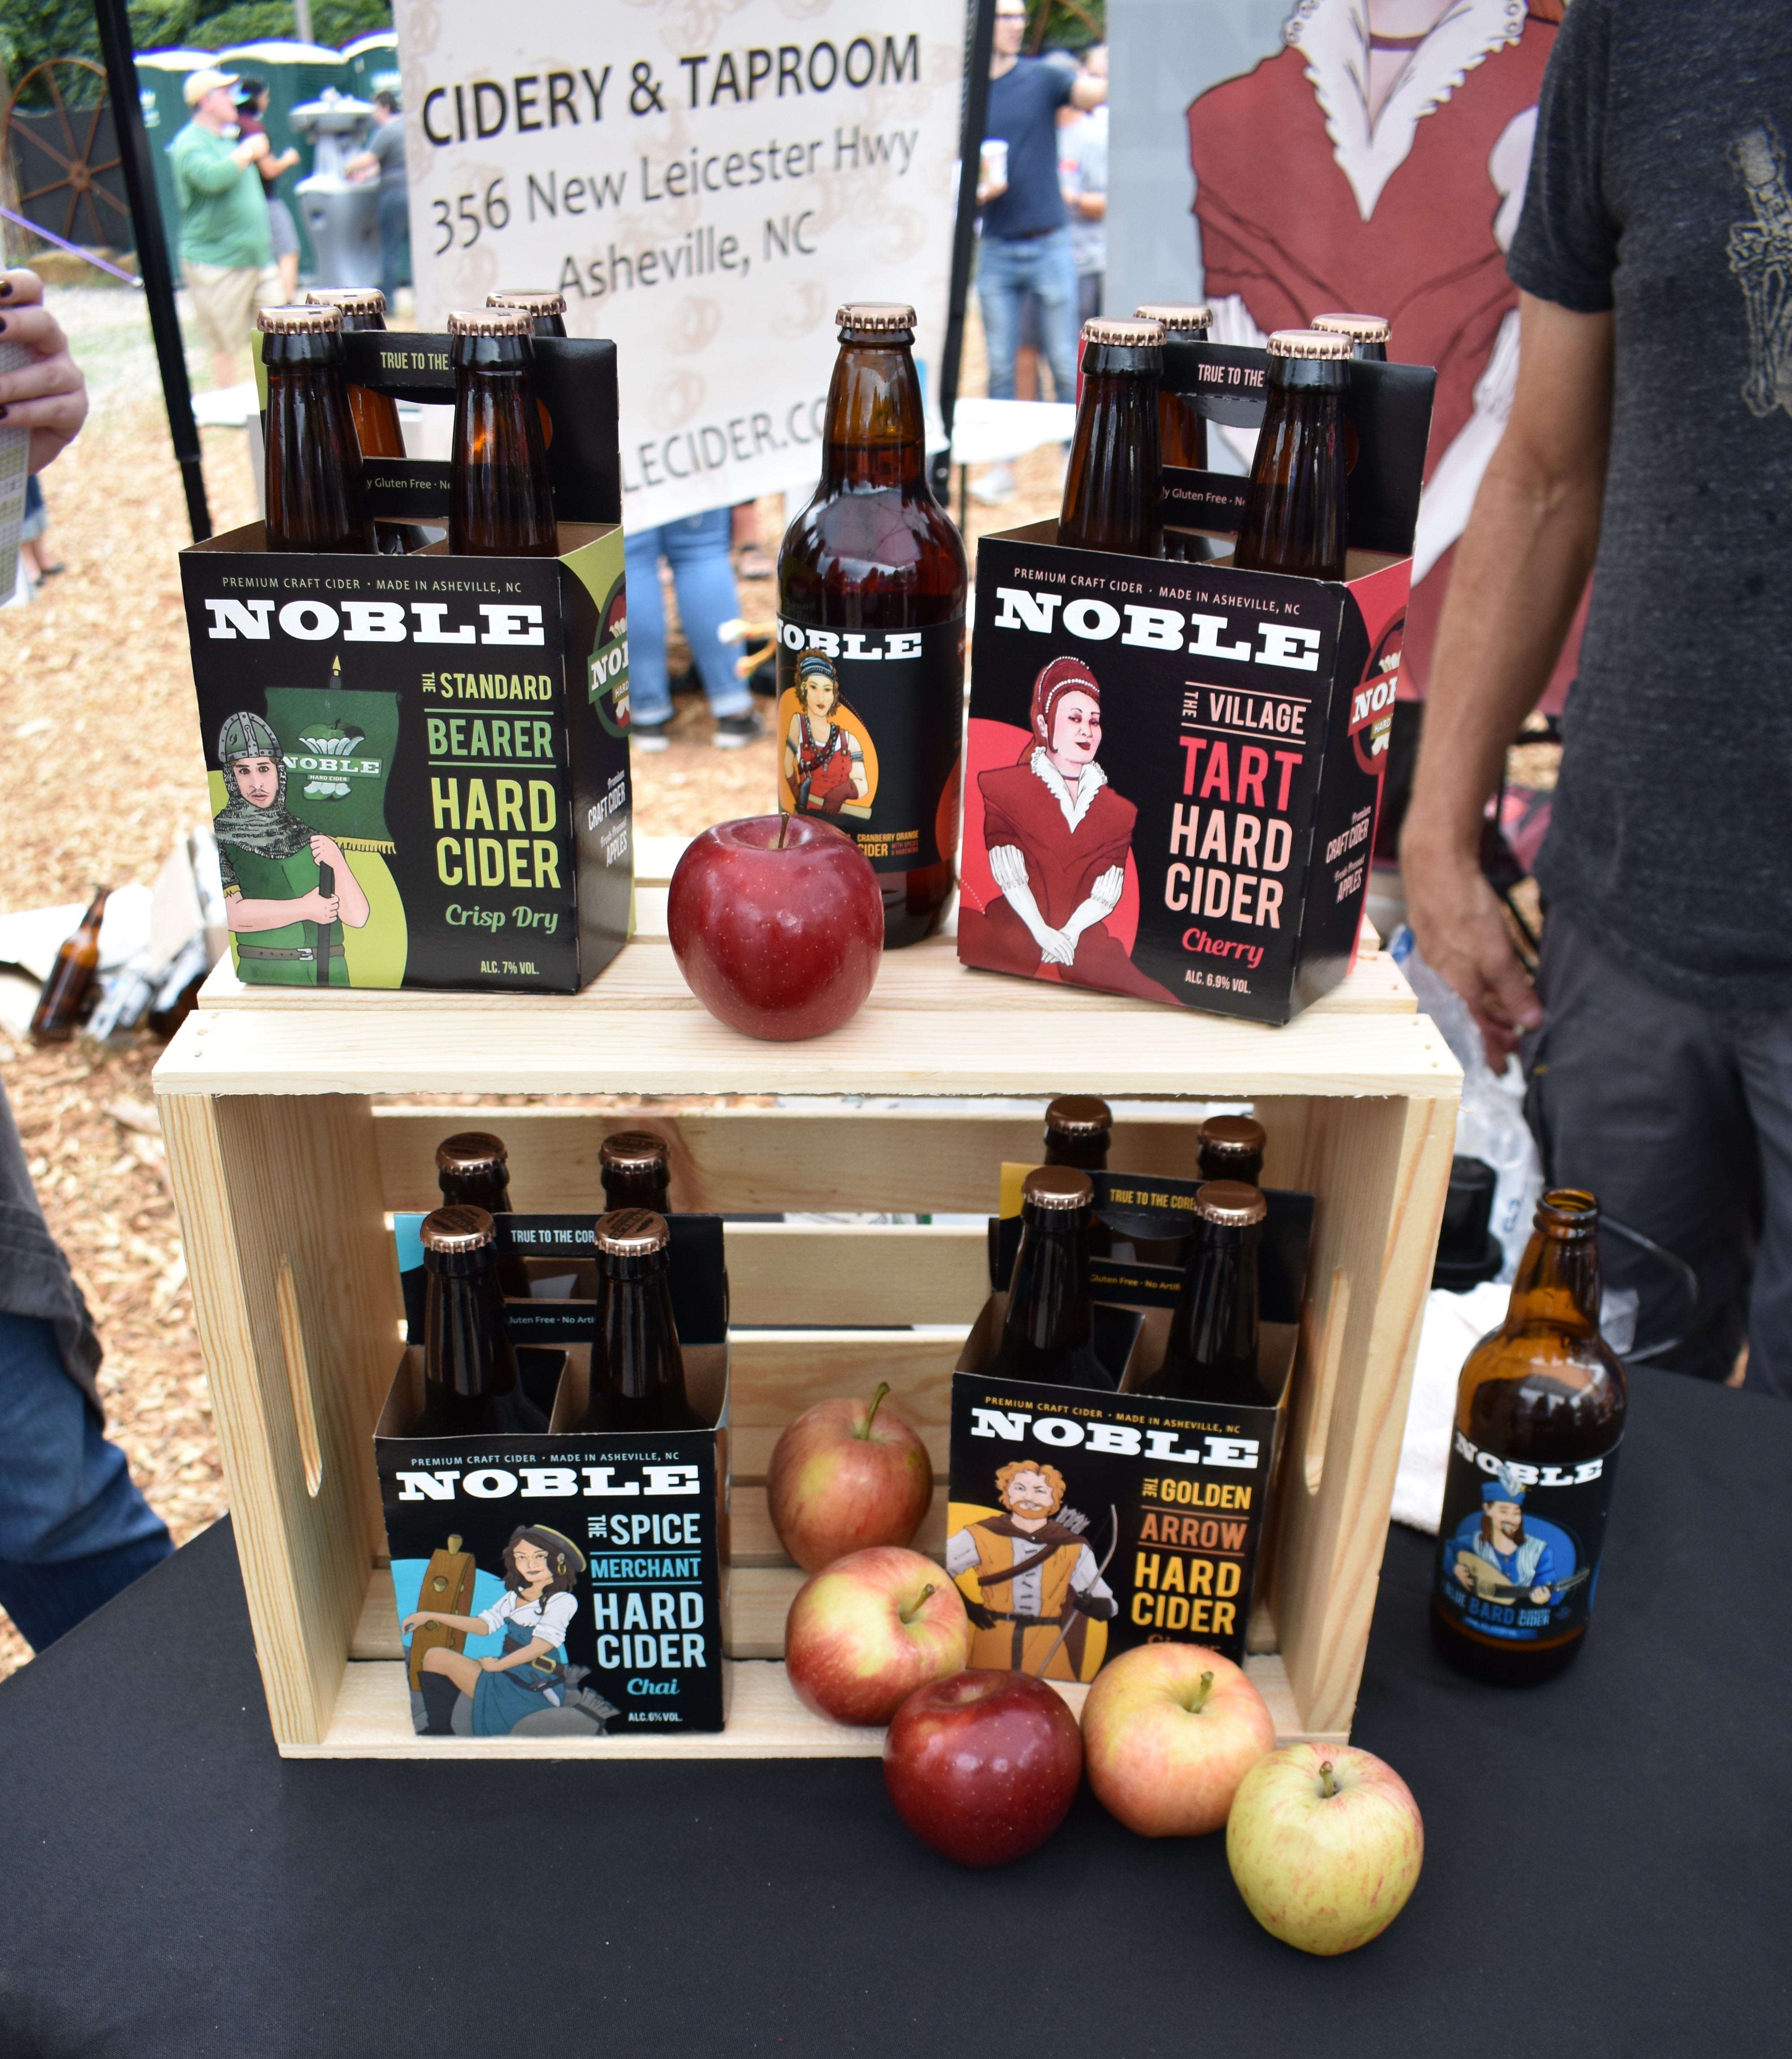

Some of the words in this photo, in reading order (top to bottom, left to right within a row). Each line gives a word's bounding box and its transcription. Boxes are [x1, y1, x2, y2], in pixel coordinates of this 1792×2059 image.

[422, 65, 612, 147] CIDERY
[629, 61, 664, 117] &
[680, 34, 920, 110] TAPROOM
[432, 179, 511, 256] 356
[527, 169, 627, 222] New
[641, 138, 823, 201] Leicester
[835, 125, 919, 175] Hwy
[558, 226, 751, 300] Asheville,
[763, 211, 817, 261] NC
[380, 352, 408, 368] TRUE
[411, 353, 425, 369] TO
[428, 354, 448, 370] THE
[1198, 364, 1225, 383] TRUE
[1228, 367, 1241, 384] TO
[1244, 369, 1265, 388] THE
[375, 478, 407, 488] Gluten
[410, 479, 431, 488] Free
[1172, 488, 1203, 501] Gluten
[1206, 492, 1227, 504] Free
[222, 577, 279, 588] PREMIUM
[283, 578, 322, 589] CRAFT
[325, 579, 361, 589] CIDER
[376, 579, 411, 591] MADE
[415, 581, 427, 591] IN
[432, 581, 500, 594] ASHEVILLE,
[506, 582, 521, 592] NC
[1014, 567, 1067, 585] PREMIUM
[1071, 575, 1106, 589] CRAFT
[1110, 580, 1143, 593] CIDER
[1159, 587, 1192, 600] MADE
[1197, 591, 1208, 603] IN
[1213, 593, 1279, 614] ASHEVILLE,
[1284, 602, 1301, 615] NC
[205, 599, 544, 646] NOBLE
[994, 587, 1321, 672] NOBLE
[422, 672, 436, 693] THE
[440, 673, 552, 701] STANDARD
[1183, 691, 1198, 717] THE
[1209, 693, 1306, 735] VILLAGE
[427, 718, 553, 758] BEARER
[283, 756, 379, 774] NOBLE
[1179, 735, 1303, 812] TART
[431, 777, 557, 833] HARD
[588, 796, 607, 831] CRAFT
[609, 781, 625, 814] CIDER
[607, 830, 627, 868] APPLES
[857, 833, 895, 842] CRANBERRY
[896, 830, 919, 840] ORANGE
[1169, 803, 1292, 872] HARD
[1326, 830, 1350, 864] CRAFT
[1348, 818, 1369, 849] CIDER
[437, 836, 561, 888] CIDER
[1166, 863, 1282, 929] CIDER
[1336, 868, 1362, 904] APPLES
[445, 904, 506, 932] Crisp
[512, 906, 558, 933] Dry
[1182, 927, 1264, 970] Cherry
[480, 960, 500, 974] ALC.
[502, 961, 516, 974] 7%
[519, 961, 539, 975] VOL.
[1185, 968, 1205, 987] ALC.
[1207, 973, 1230, 991] 6.9%
[1232, 977, 1251, 994] VOL.
[1110, 1188, 1134, 1204] TRUE
[1137, 1191, 1149, 1205] TO
[1150, 1193, 1169, 1208] THE
[511, 1230, 537, 1243] TRUE
[538, 1230, 552, 1243] TO
[553, 1230, 573, 1243] THE
[1119, 1277, 1139, 1286] Free
[1144, 1280, 1158, 1289] No
[535, 1316, 555, 1324] Free
[562, 1316, 575, 1324] No
[985, 1396, 1034, 1410] PREMIUM
[1037, 1403, 1069, 1414] CRAFT
[1072, 1406, 1103, 1418] CIDER
[1116, 1413, 1146, 1424] MADE
[1148, 1416, 1160, 1426] IN
[1163, 1418, 1223, 1433] ASHEVILLE,
[1226, 1424, 1241, 1433] NC
[971, 1407, 1259, 1469] NOBLE
[411, 1455, 463, 1467] PREMIUM
[466, 1455, 501, 1465] CRAFT
[504, 1454, 537, 1463] CIDER
[550, 1453, 582, 1463] MADE
[585, 1453, 596, 1462] IN
[600, 1452, 662, 1463] ASHEVILLE,
[665, 1451, 679, 1460] NC
[1455, 1431, 1603, 1486] NOBLE
[396, 1465, 700, 1501] NOBLE
[1142, 1478, 1158, 1498] THE
[1160, 1478, 1252, 1510] GOLDEN
[587, 1514, 607, 1539] THE
[610, 1513, 702, 1545] SPICE
[1140, 1513, 1248, 1550] ARROW
[590, 1557, 702, 1579] MERCHANT
[1134, 1552, 1242, 1597] HARD
[593, 1592, 704, 1630] HARD
[1131, 1592, 1235, 1636] CIDER
[1468, 1596, 1515, 1625] BARD
[1517, 1615, 1550, 1627] CIDER
[596, 1633, 706, 1669] CIDER
[627, 1678, 680, 1696] Chai
[663, 1712, 683, 1722] VOL.
